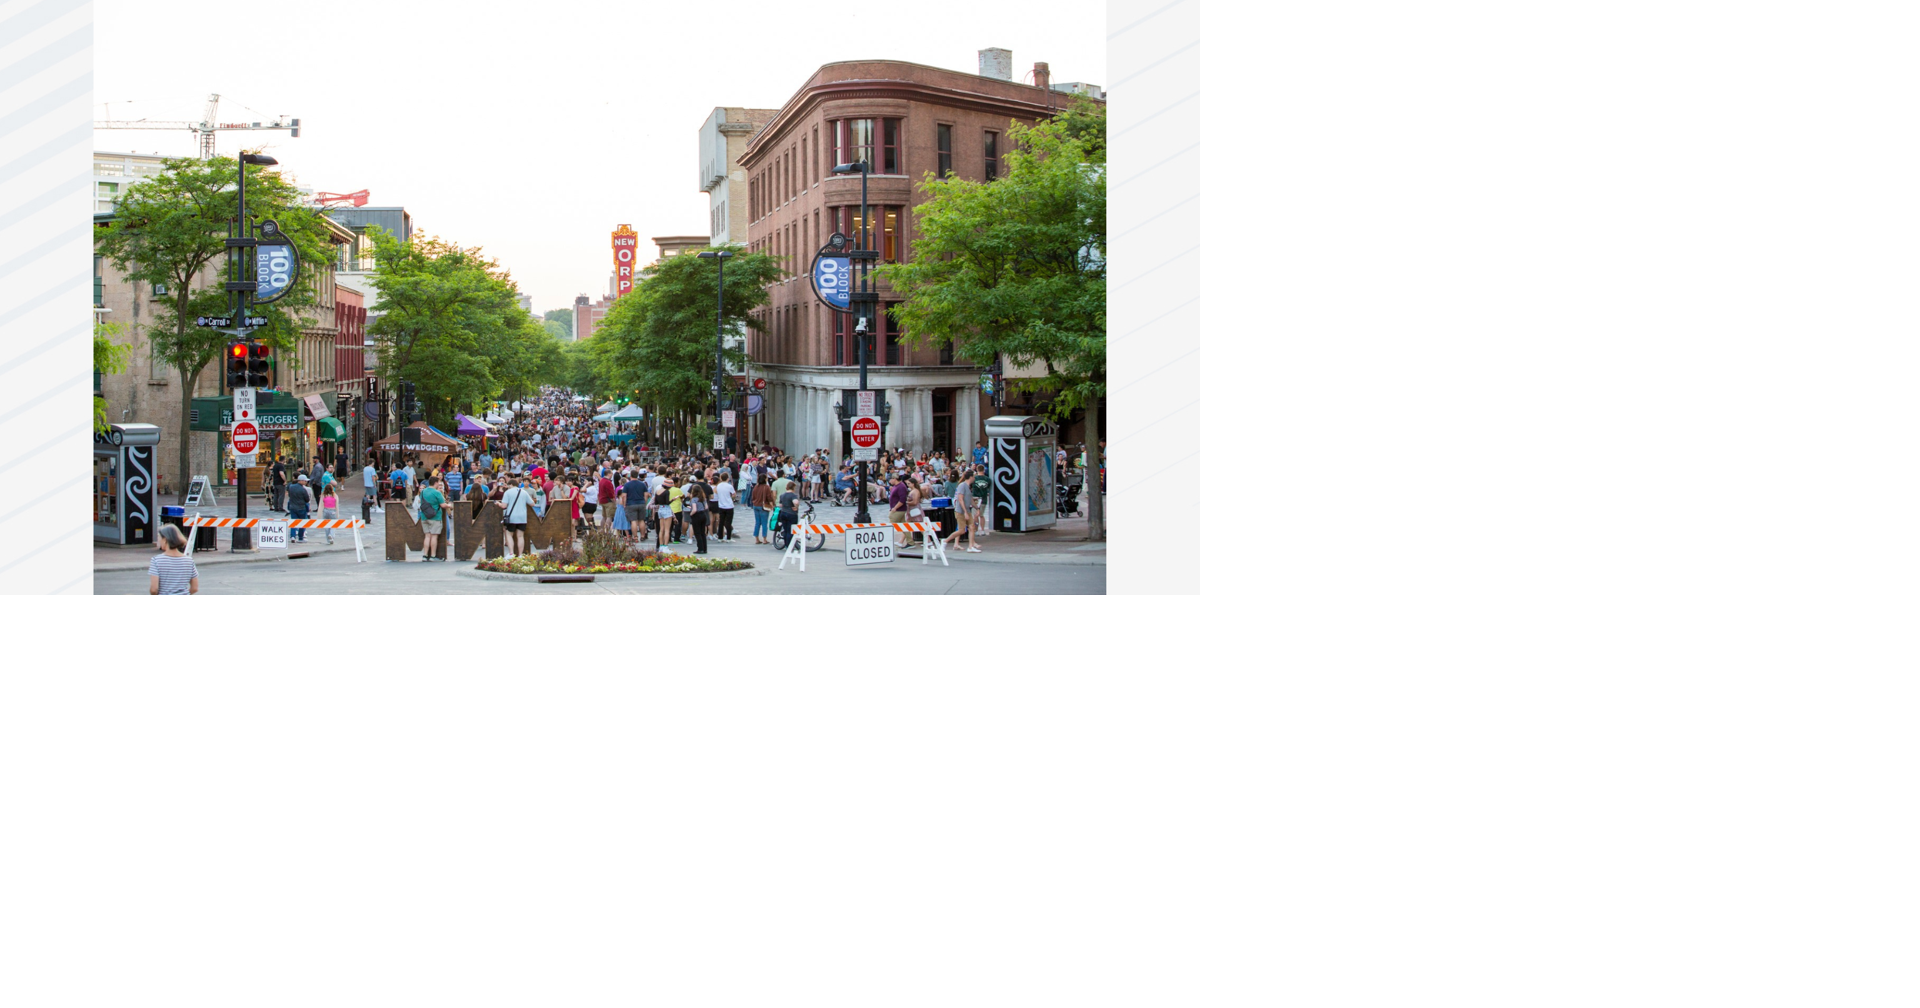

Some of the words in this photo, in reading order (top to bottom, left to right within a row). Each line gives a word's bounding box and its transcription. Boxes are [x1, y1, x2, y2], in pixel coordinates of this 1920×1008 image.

[614, 238, 635, 246] NEW
[258, 254, 269, 289] BLOCK
[270, 247, 289, 288] 100
[618, 249, 632, 297] ORP
[820, 259, 838, 298] 100
[838, 266, 849, 299] BLOCK
[208, 317, 226, 326] Carroll
[848, 378, 876, 386] BAK
[715, 441, 723, 449] 15
[261, 525, 284, 534] WALK
[261, 535, 285, 543] BIKES
[855, 531, 885, 544] ROAD
[850, 546, 891, 560] CLOSED
